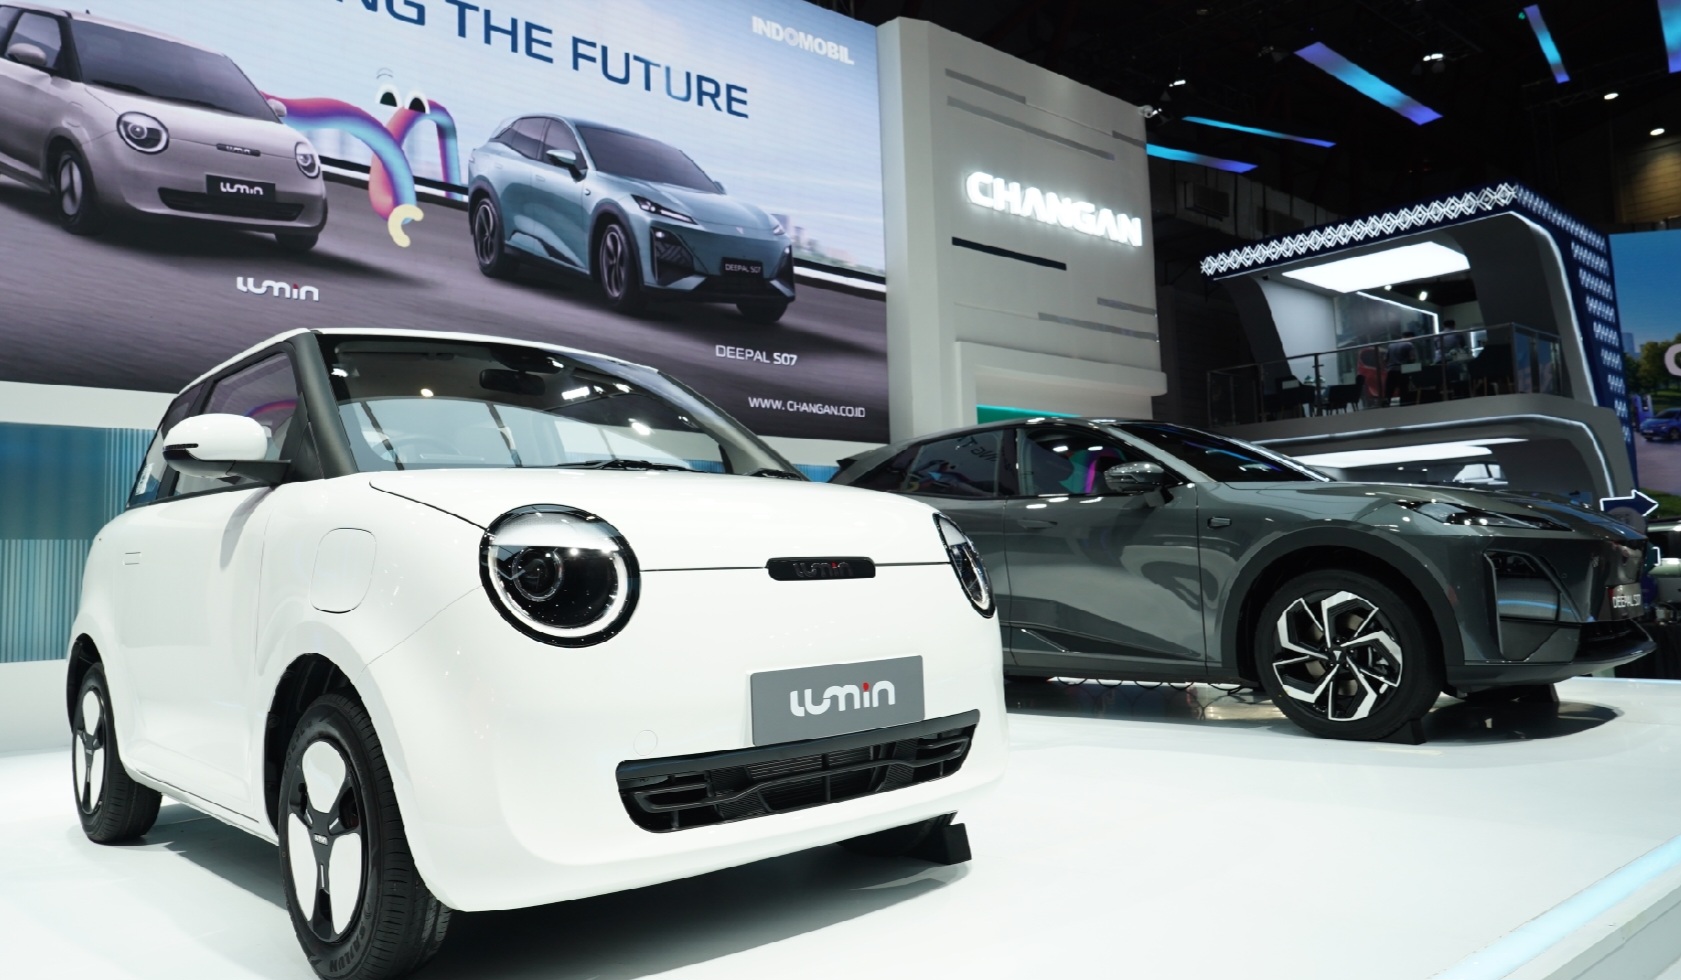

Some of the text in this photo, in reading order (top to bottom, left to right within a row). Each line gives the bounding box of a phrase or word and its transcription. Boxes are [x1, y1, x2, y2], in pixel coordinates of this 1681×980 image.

[445, 0, 749, 119] THE FUTURE
[752, 15, 855, 65] INDOMOBIL
[966, 171, 1143, 247] CHANGAN
[715, 344, 798, 366] DEEPAL S07
